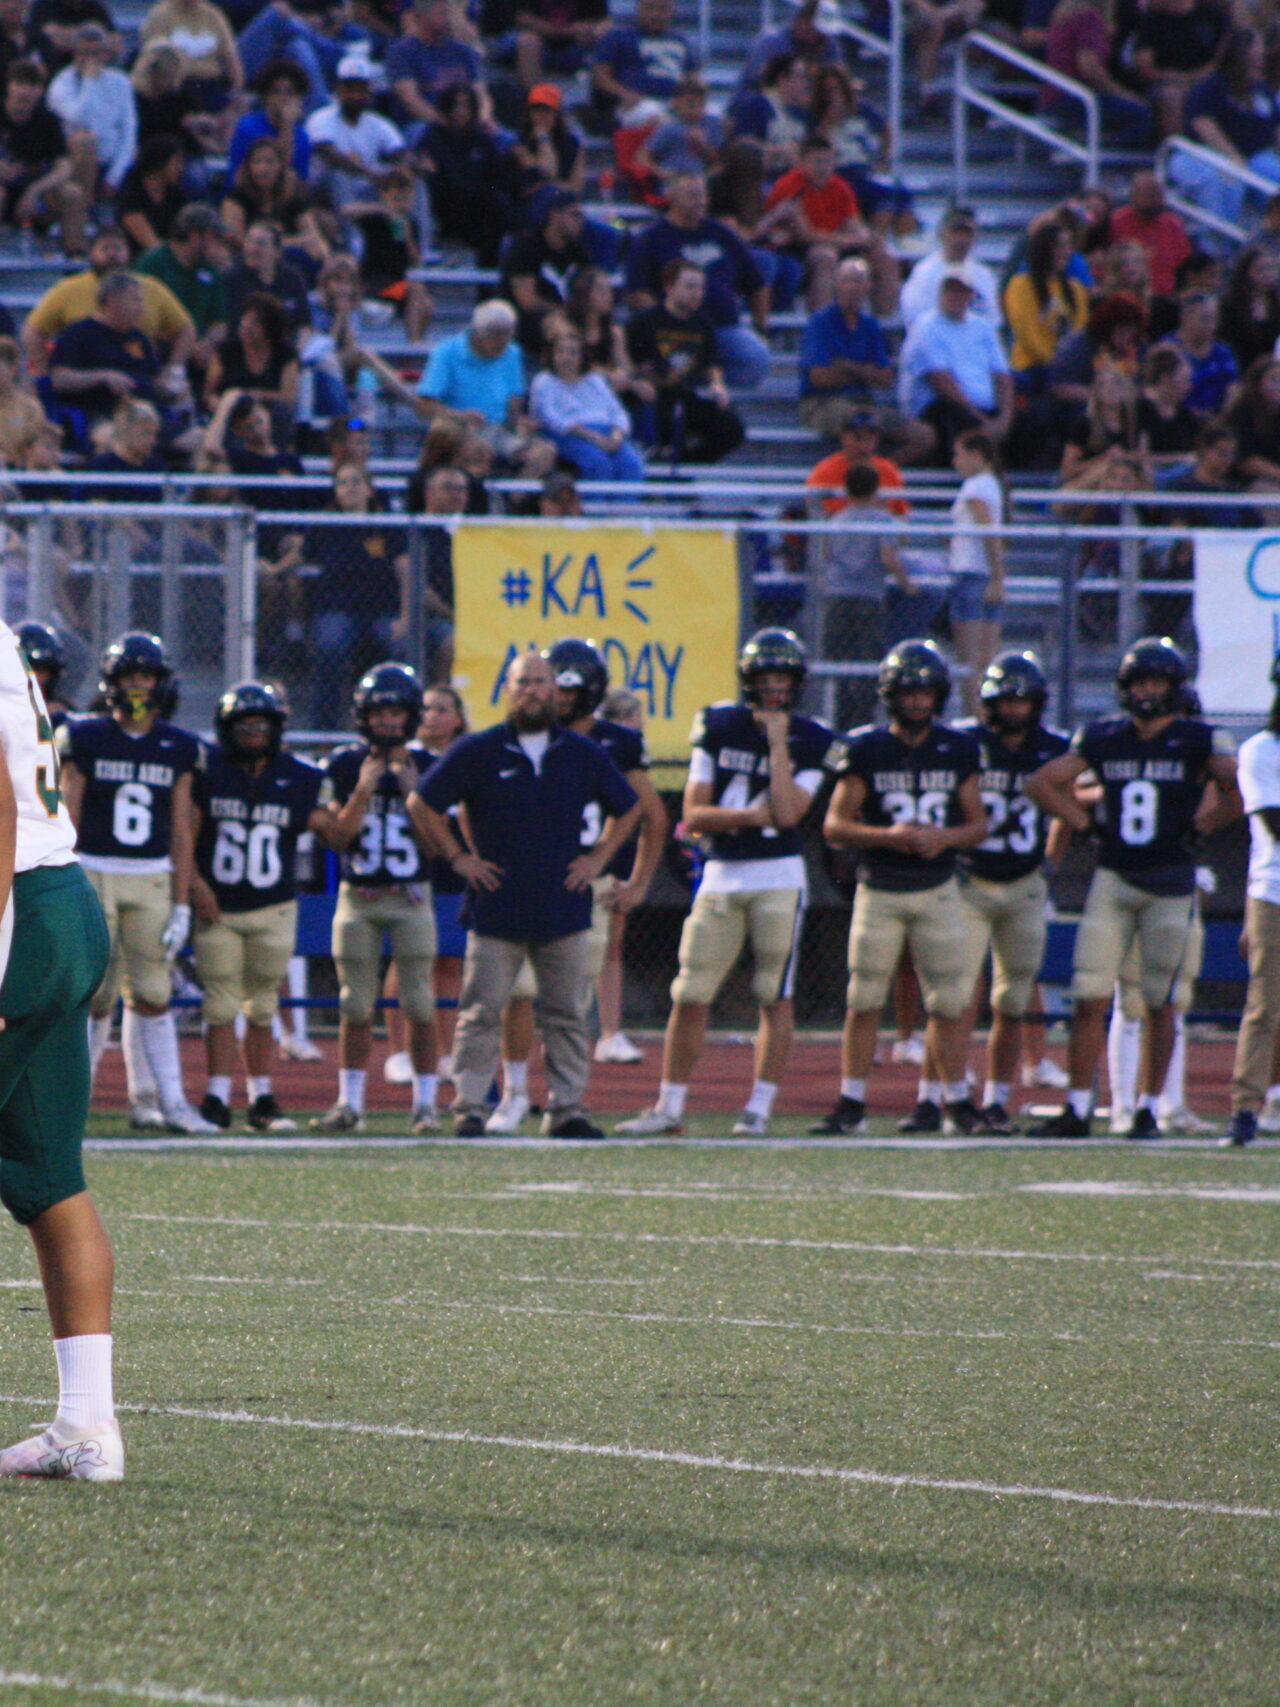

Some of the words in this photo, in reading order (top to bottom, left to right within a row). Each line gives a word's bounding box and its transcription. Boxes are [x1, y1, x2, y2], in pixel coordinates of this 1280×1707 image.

[501, 552, 608, 619] #KA
[112, 781, 154, 847] 6
[350, 812, 419, 878] 35
[976, 791, 1038, 855] 23
[1120, 779, 1157, 846] 8
[211, 819, 283, 889] 60
